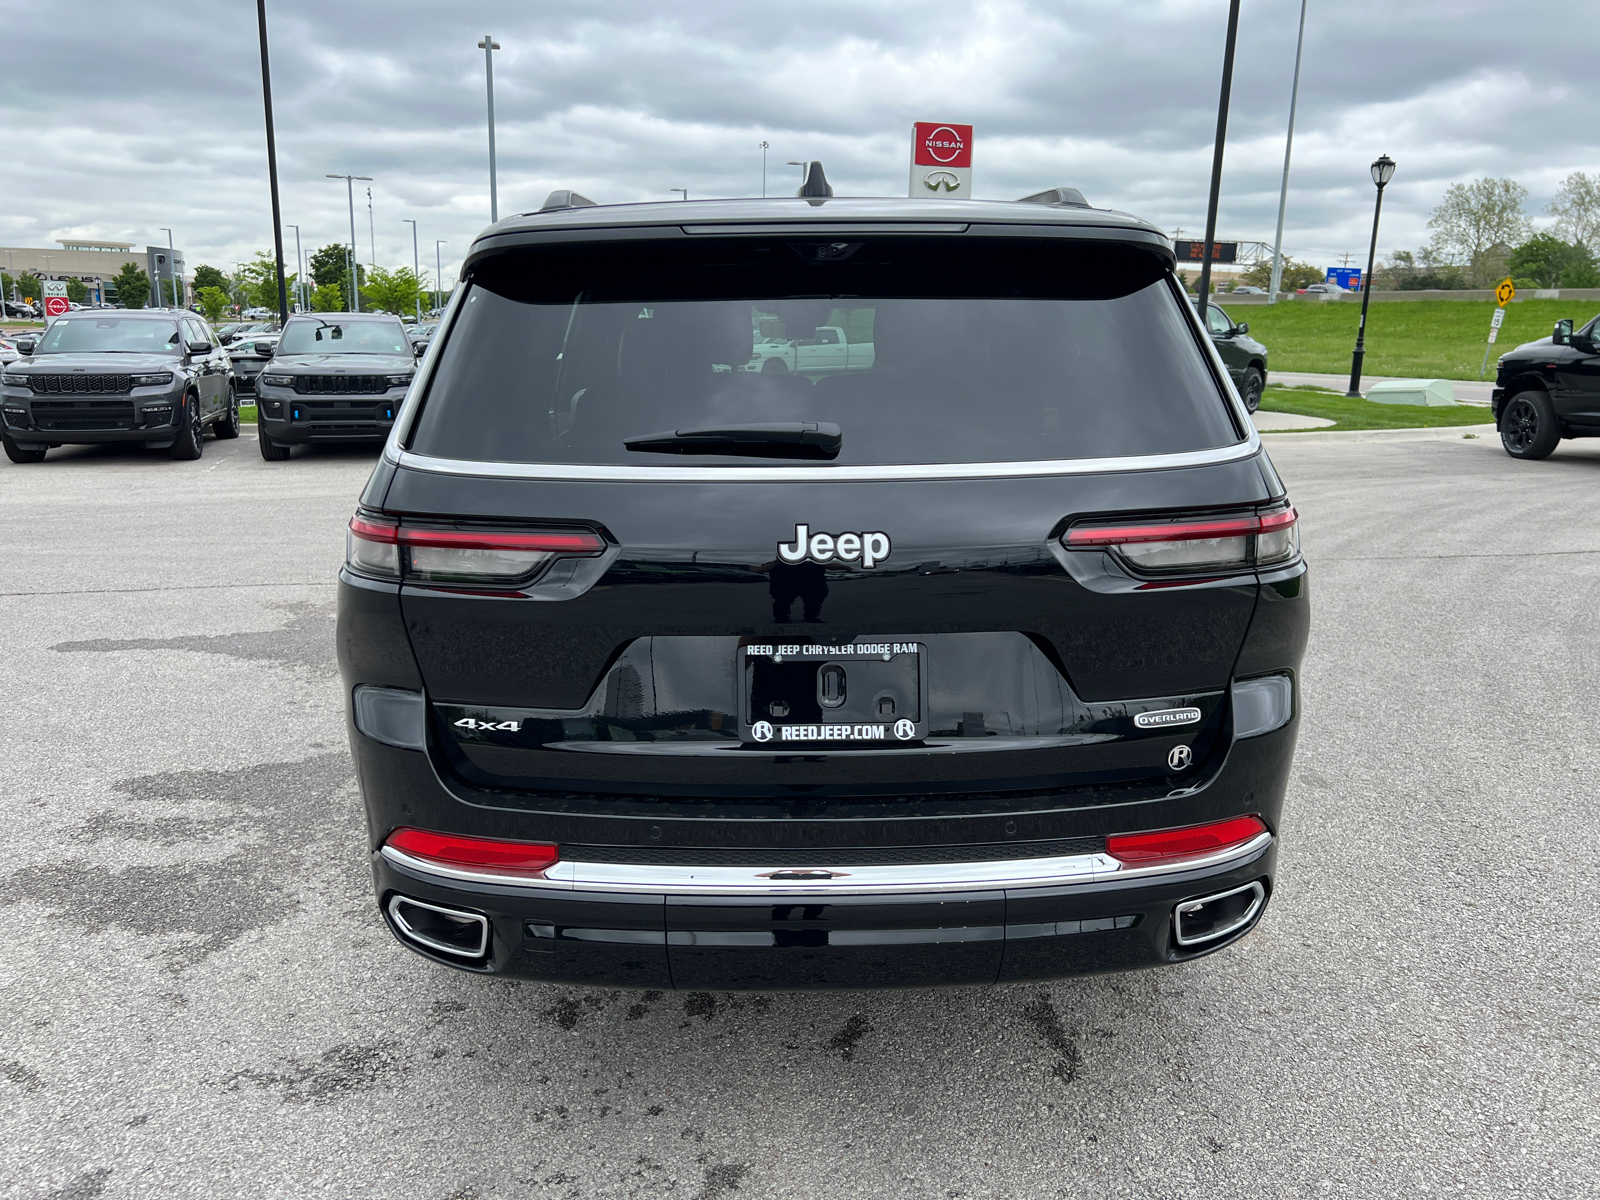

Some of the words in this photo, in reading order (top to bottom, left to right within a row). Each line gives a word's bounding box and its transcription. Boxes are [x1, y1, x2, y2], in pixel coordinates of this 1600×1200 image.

[925, 140, 964, 149] NISSAN
[779, 524, 890, 568] Jeep
[747, 645, 773, 655] REED
[776, 645, 800, 655] JEEP
[803, 644, 854, 655] CHRYSLER
[857, 643, 890, 654] DODGE
[893, 643, 918, 653] RAM
[1139, 711, 1198, 724] OVERLAND
[453, 718, 522, 732] 4x4
[781, 725, 885, 740] REEDJEEP.COM
